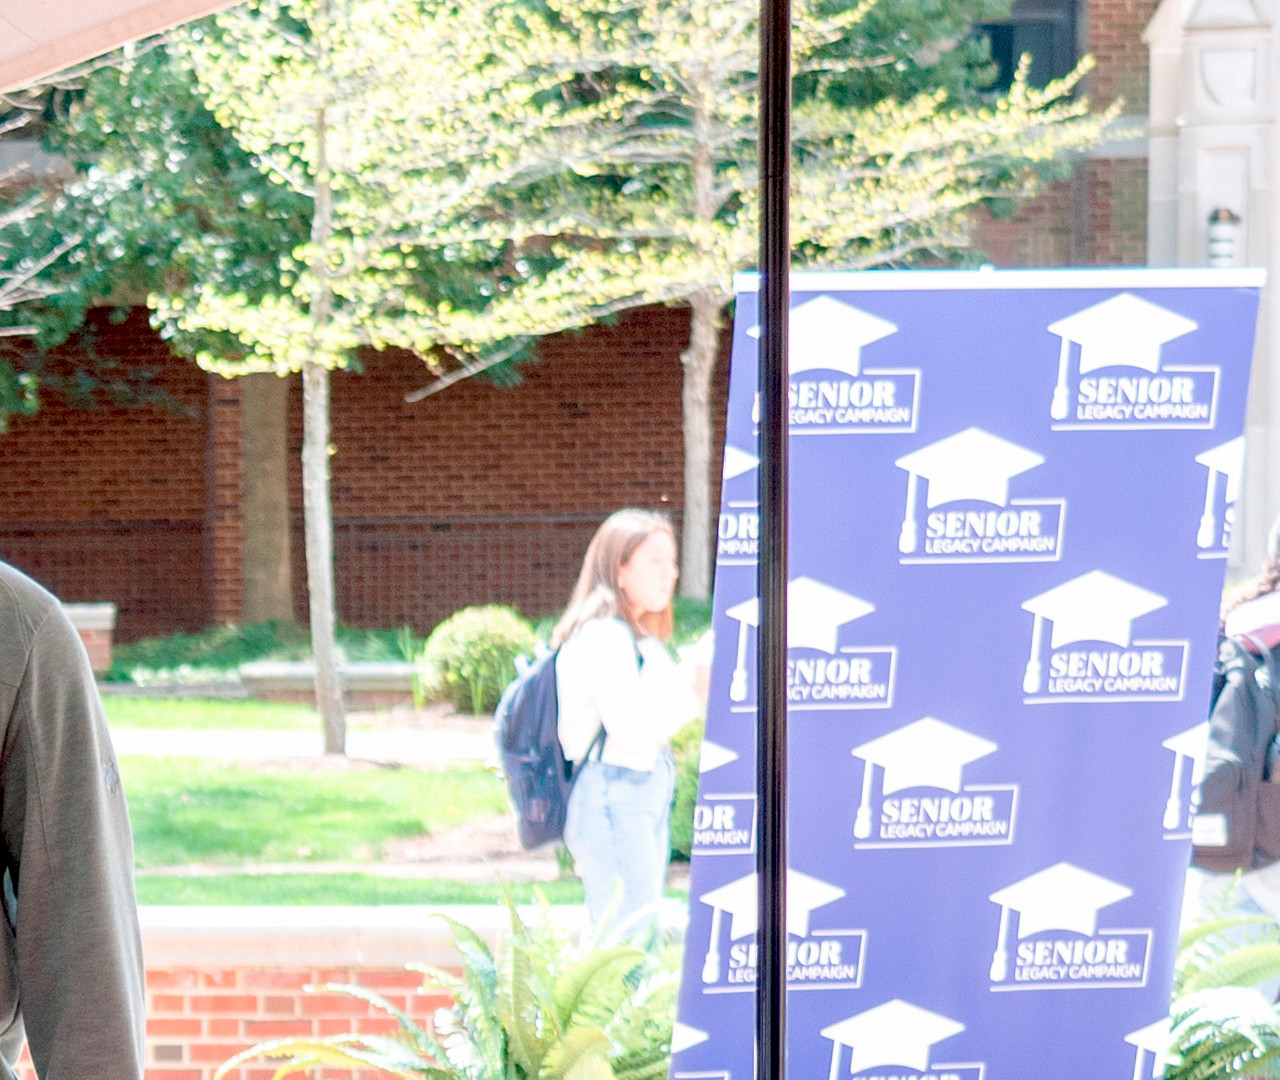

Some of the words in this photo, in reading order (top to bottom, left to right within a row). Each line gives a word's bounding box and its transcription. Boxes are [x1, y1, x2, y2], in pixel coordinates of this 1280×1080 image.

[1078, 377, 1194, 404] SENIOR
[835, 406, 910, 423] CAMPAIGN
[1077, 404, 1132, 420] LEGACY
[1133, 403, 1208, 420] CAMPAIGN
[926, 510, 1042, 538] SENIOR
[925, 538, 980, 554] LEGACY
[982, 536, 1055, 553] CAMPAIGN
[788, 657, 872, 685] NIOR
[1050, 651, 1163, 678] SENIOR
[811, 683, 886, 700] CAMPAIGN
[1048, 677, 1102, 693] LEGACY
[1104, 677, 1177, 693] CAMPAIGN
[881, 796, 994, 824] SENIOR
[880, 823, 935, 839] LEGACY
[936, 820, 1006, 837] CAMPAIGN
[1016, 939, 1128, 967] SENIOR
[1014, 965, 1067, 981] LEGACY
[1069, 963, 1140, 980] CAMPAIGN
